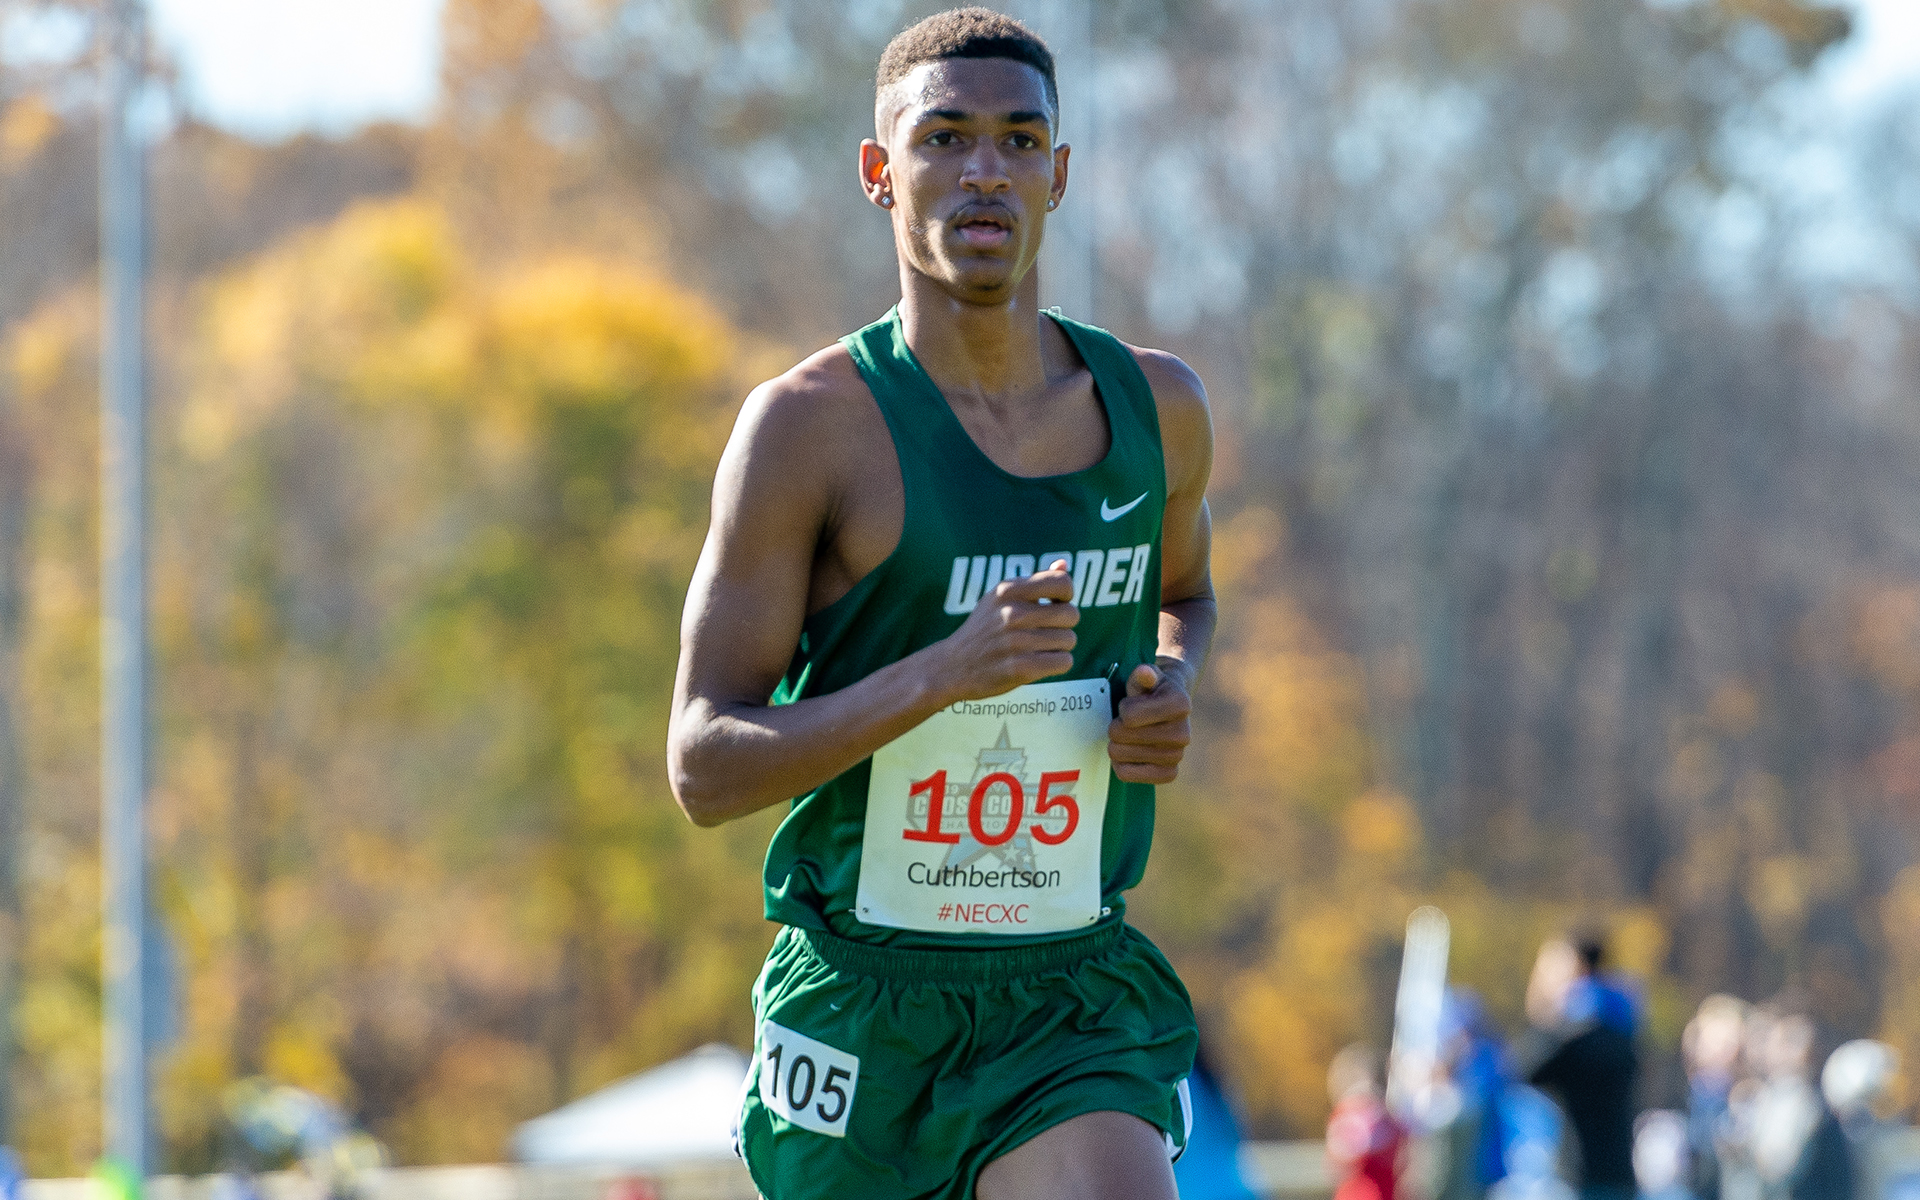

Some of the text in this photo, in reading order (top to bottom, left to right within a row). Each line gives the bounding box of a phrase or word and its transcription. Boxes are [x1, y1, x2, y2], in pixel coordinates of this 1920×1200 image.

[951, 694, 1092, 718] Championship 2019
[902, 769, 1080, 846] 105
[907, 862, 1060, 888] Cuthbertson
[937, 903, 1029, 924] #NECXC
[767, 1043, 851, 1123] 105
